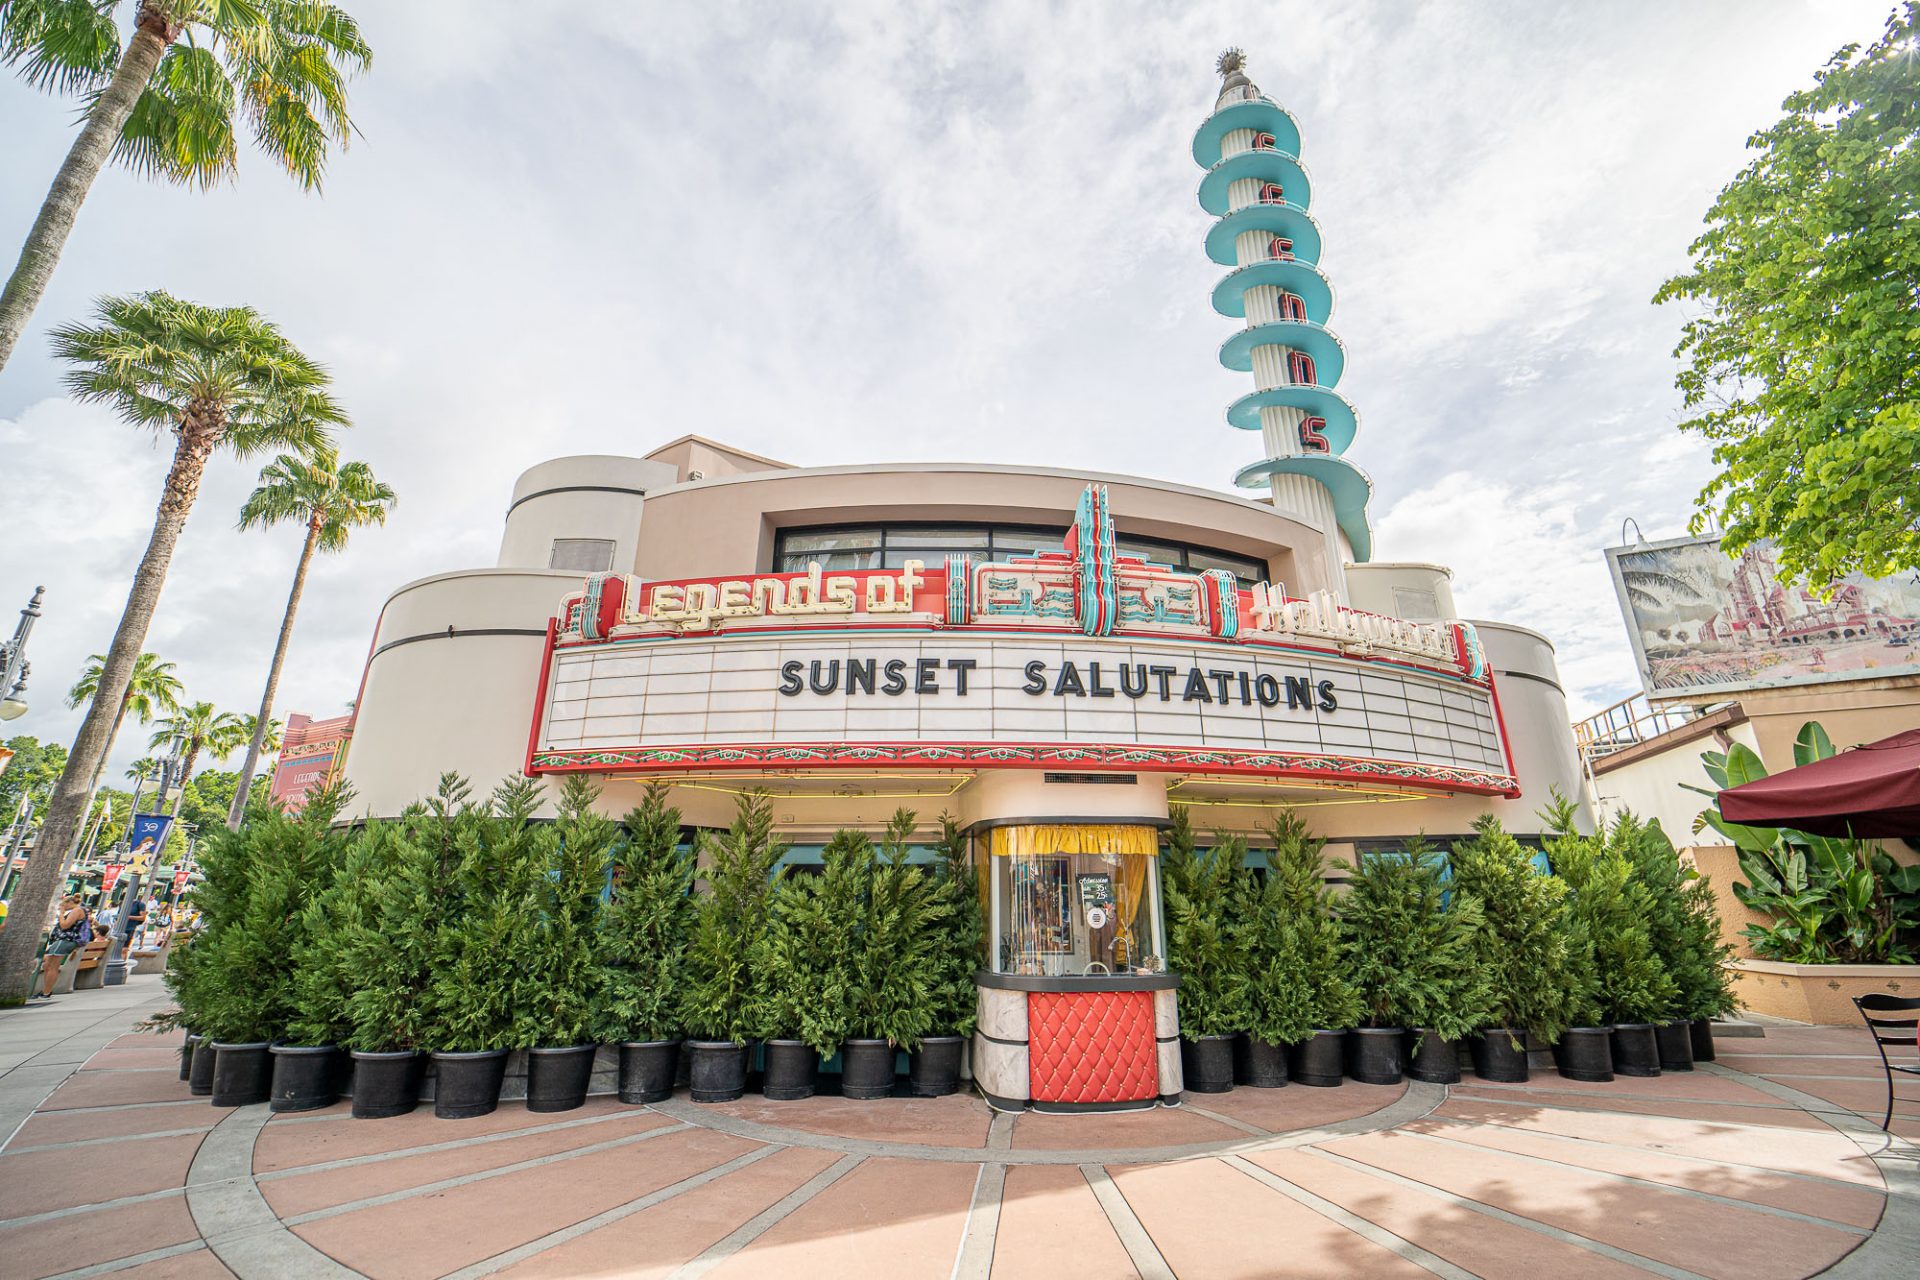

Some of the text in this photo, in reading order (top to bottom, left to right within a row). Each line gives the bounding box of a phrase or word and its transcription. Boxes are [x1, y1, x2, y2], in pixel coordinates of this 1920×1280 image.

[620, 561, 857, 631] Legends
[866, 559, 924, 613] of
[778, 658, 1338, 713] SUNSET SALUTATIONS
